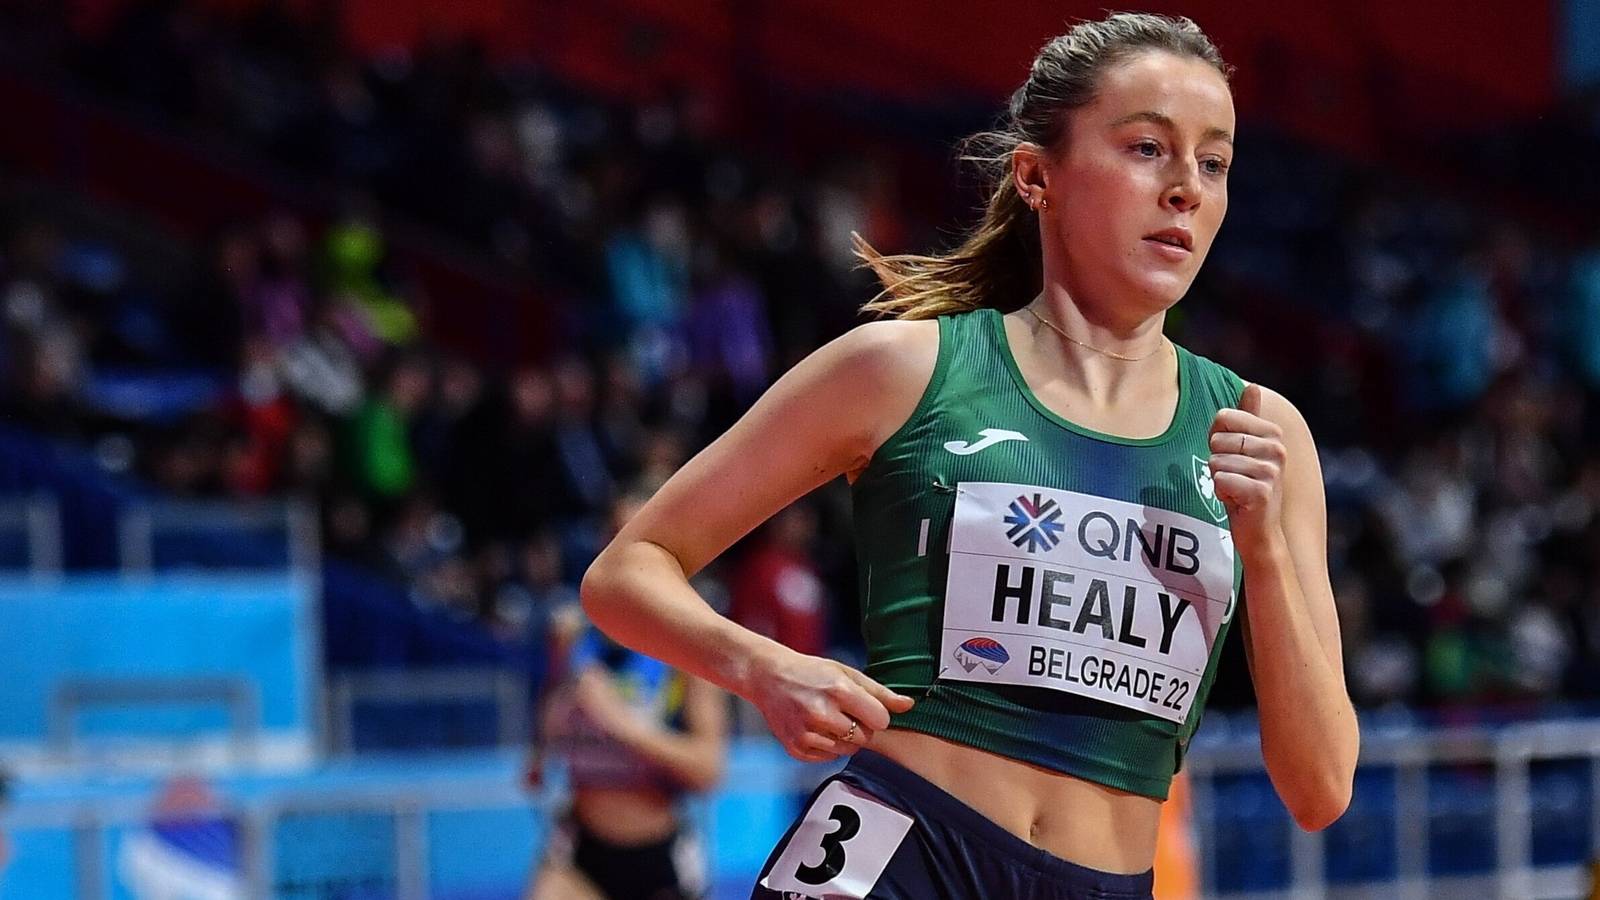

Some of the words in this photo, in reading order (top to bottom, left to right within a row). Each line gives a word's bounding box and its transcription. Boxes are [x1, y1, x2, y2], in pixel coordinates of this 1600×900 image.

[1077, 511, 1200, 575] QNB
[991, 564, 1191, 655] HEALY
[1028, 645, 1166, 704] BELGRADE
[1162, 677, 1190, 711] 22
[794, 804, 861, 885] 3
